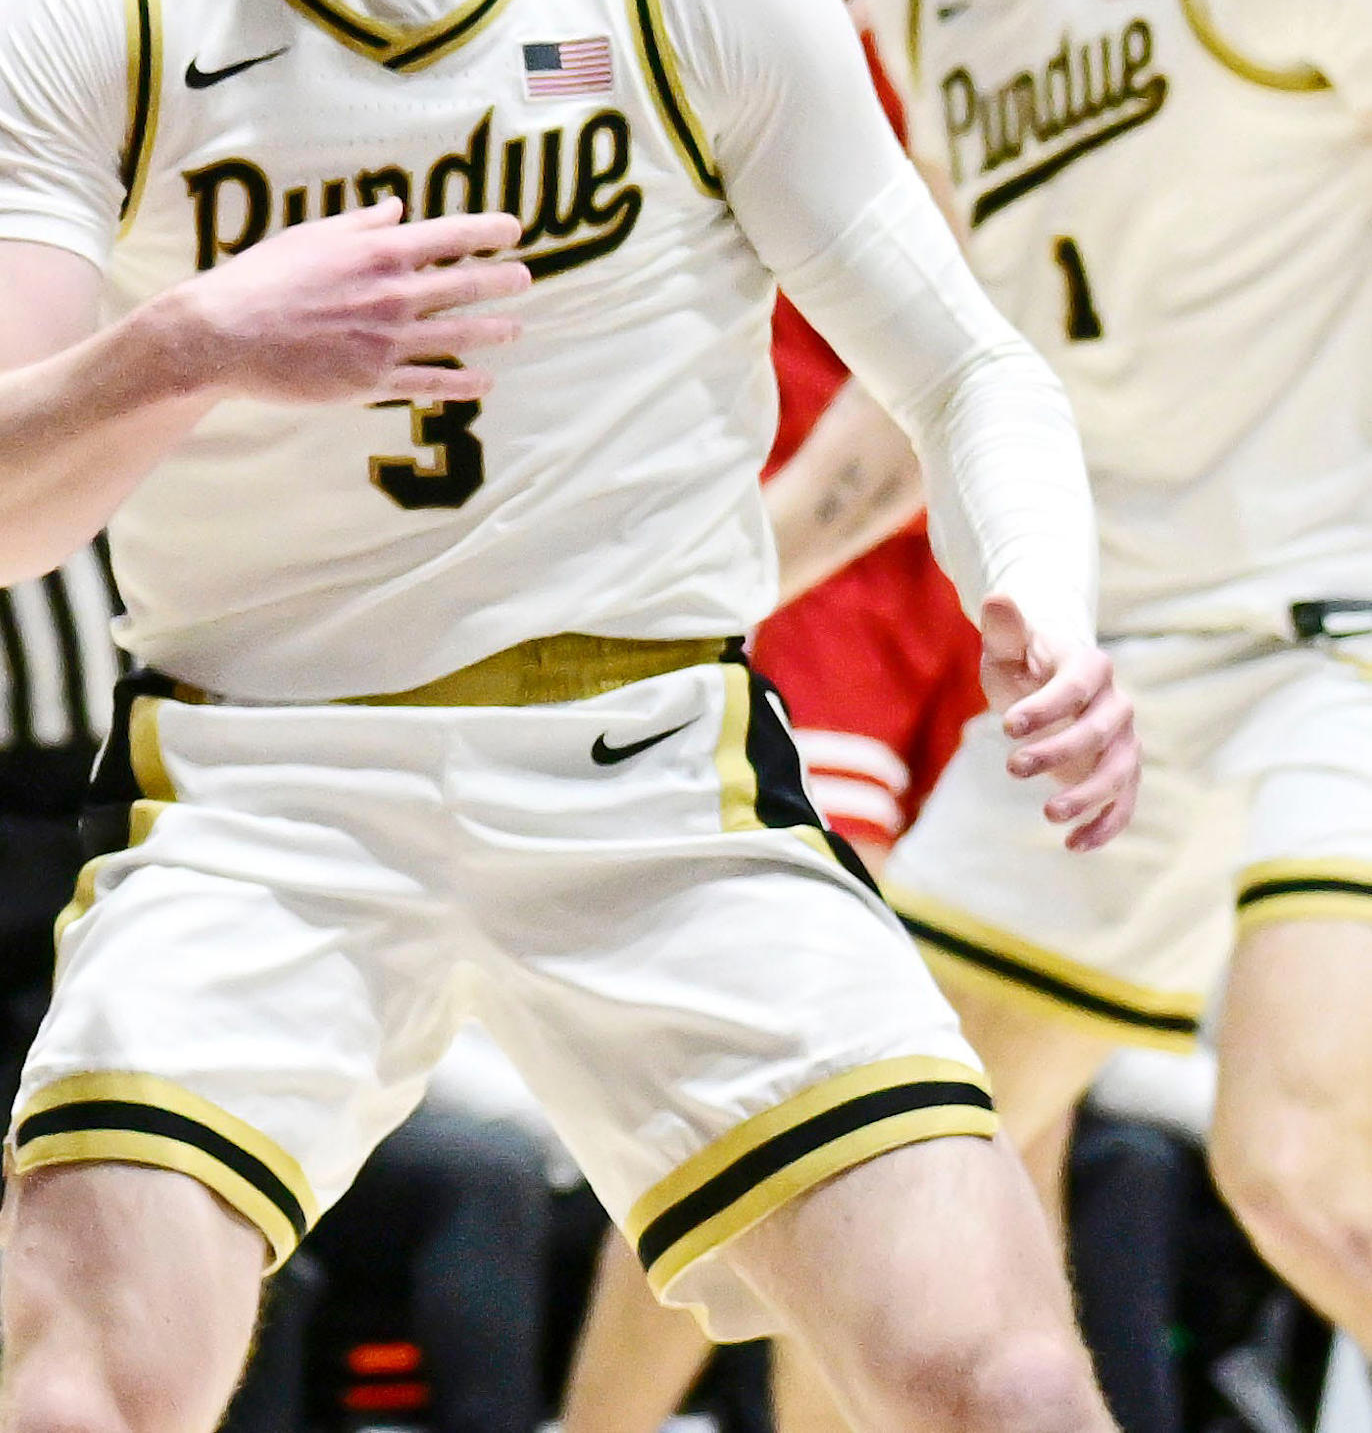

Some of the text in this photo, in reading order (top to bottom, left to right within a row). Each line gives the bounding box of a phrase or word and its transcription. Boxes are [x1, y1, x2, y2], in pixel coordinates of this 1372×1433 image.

[940, 17, 1169, 229] Purdue
[1053, 234, 1102, 342] 1
[368, 354, 486, 511] 3
